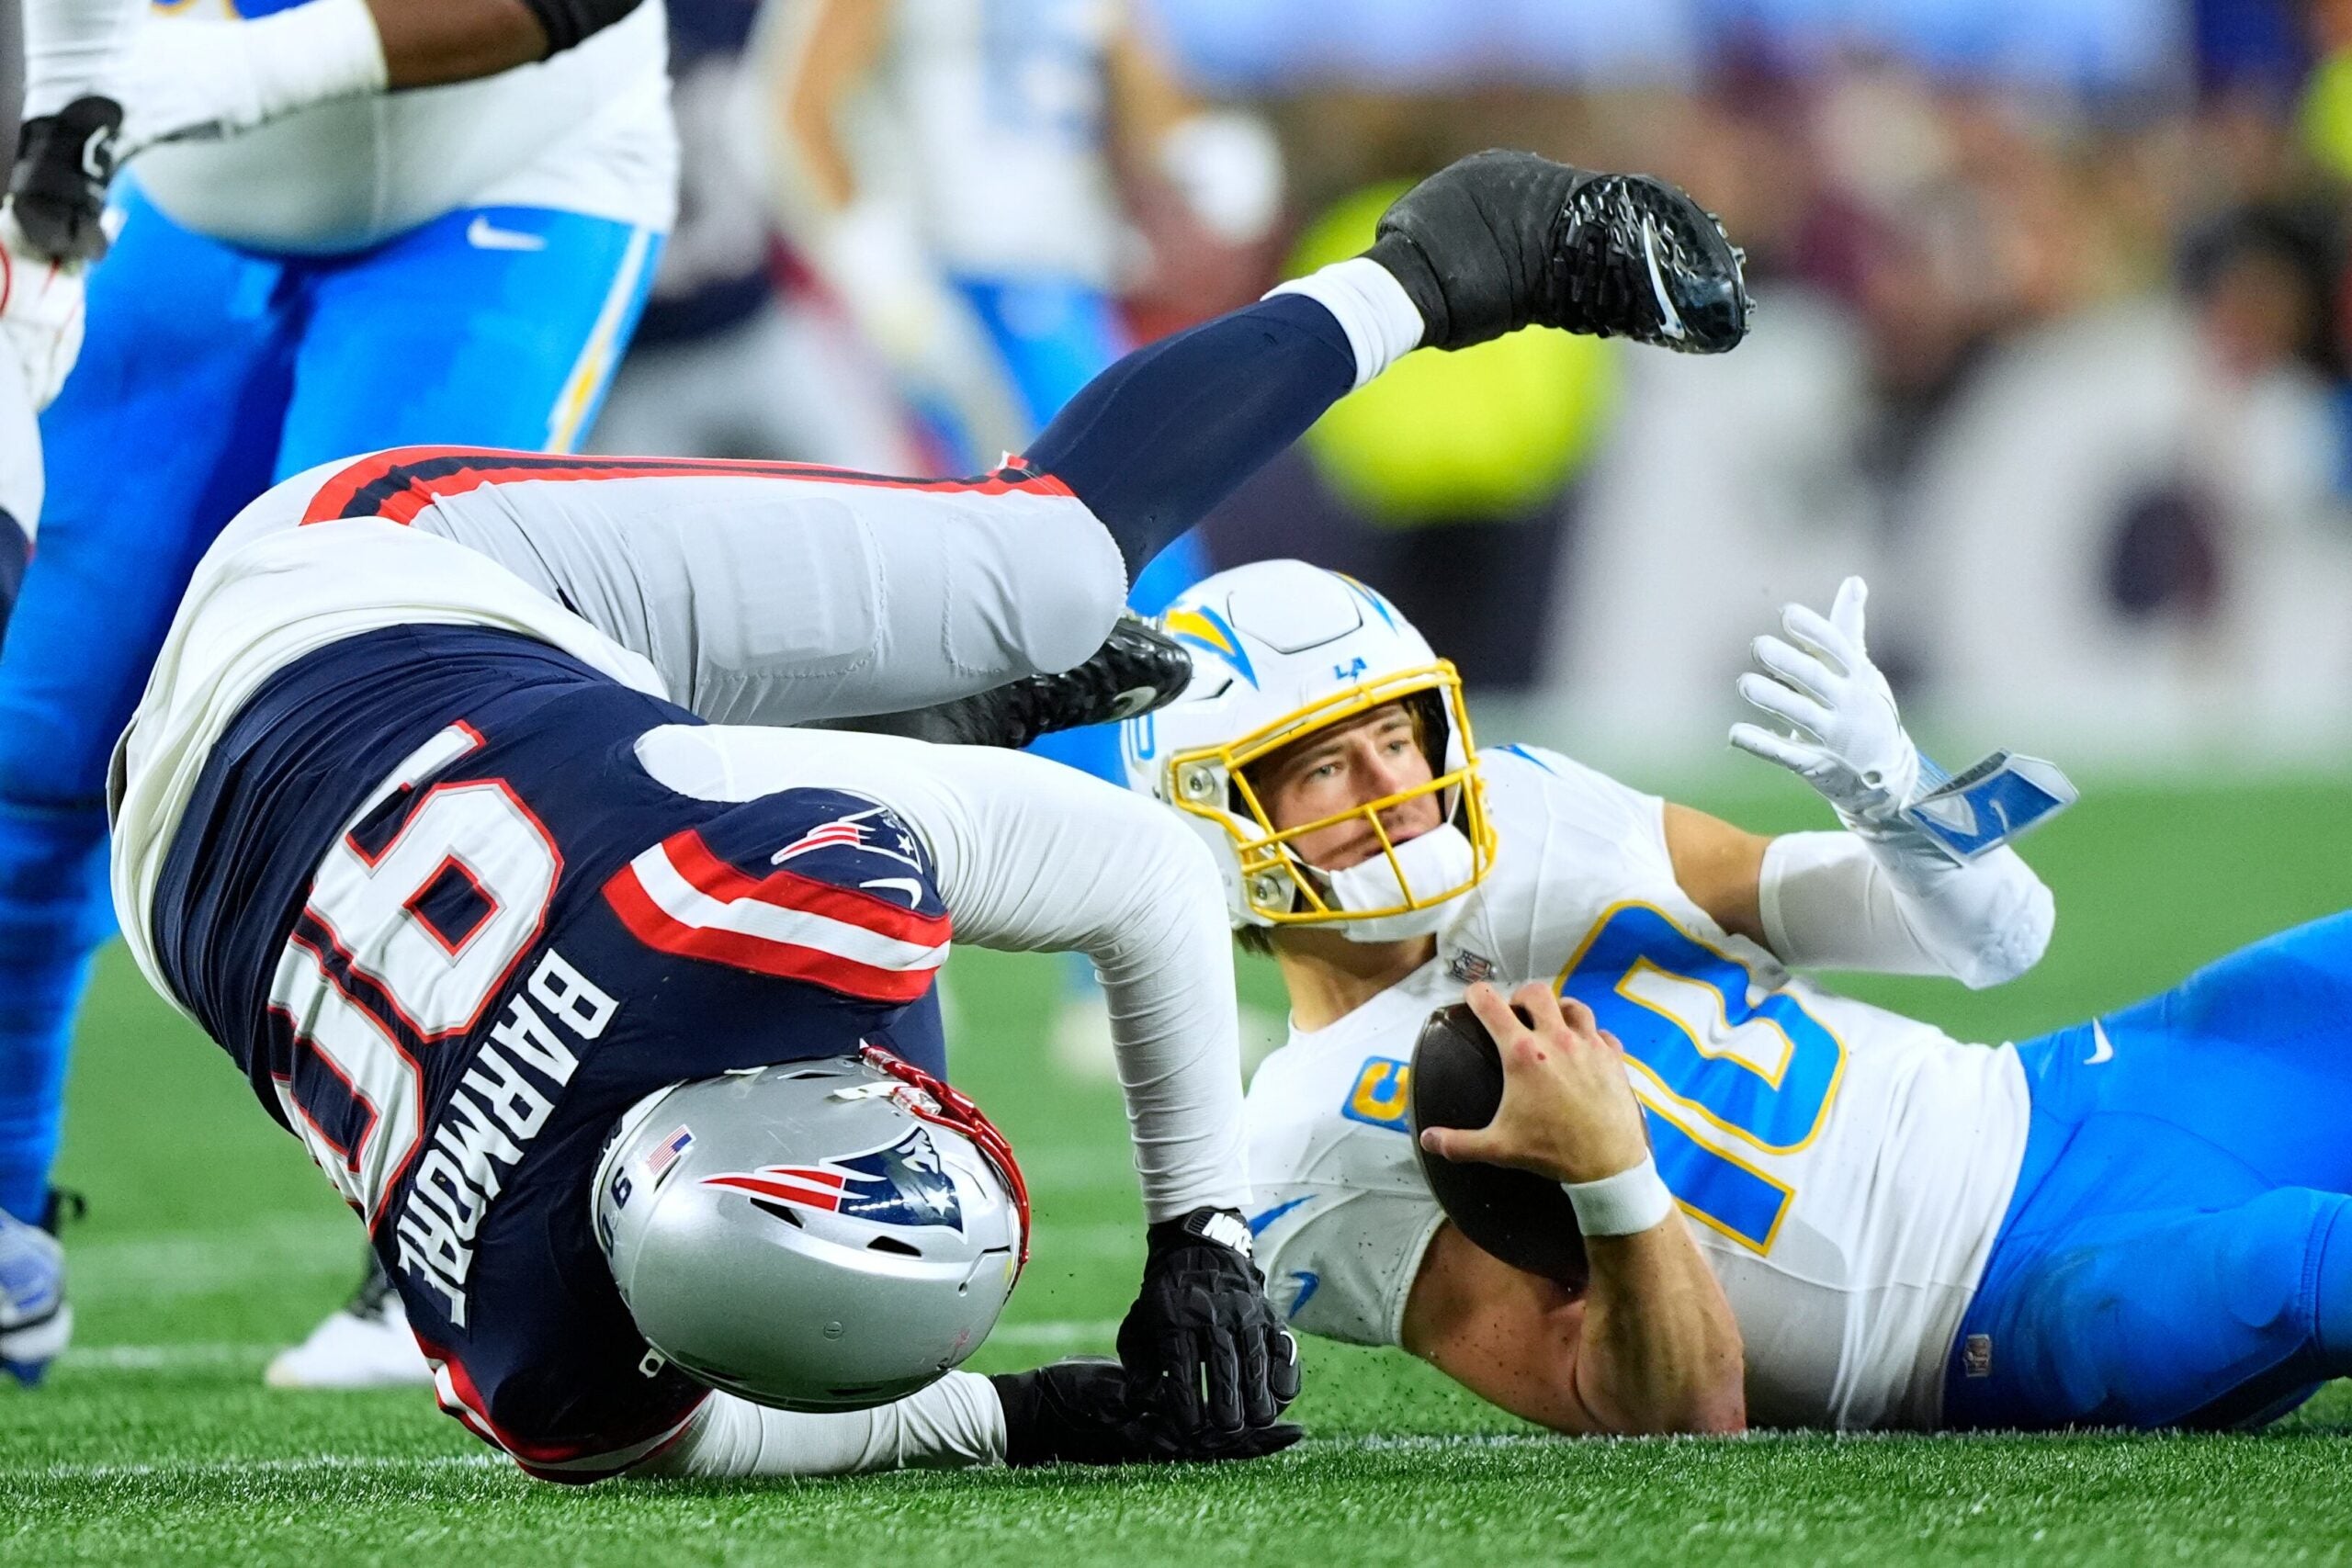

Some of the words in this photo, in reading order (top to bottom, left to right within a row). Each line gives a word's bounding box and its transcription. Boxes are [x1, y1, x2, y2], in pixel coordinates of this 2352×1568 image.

[1333, 656, 1367, 683] LA
[267, 719, 565, 1240] 90
[1351, 1062, 1409, 1121] C
[1553, 899, 1848, 1258] 10
[1202, 1213, 1252, 1258] NIKE
